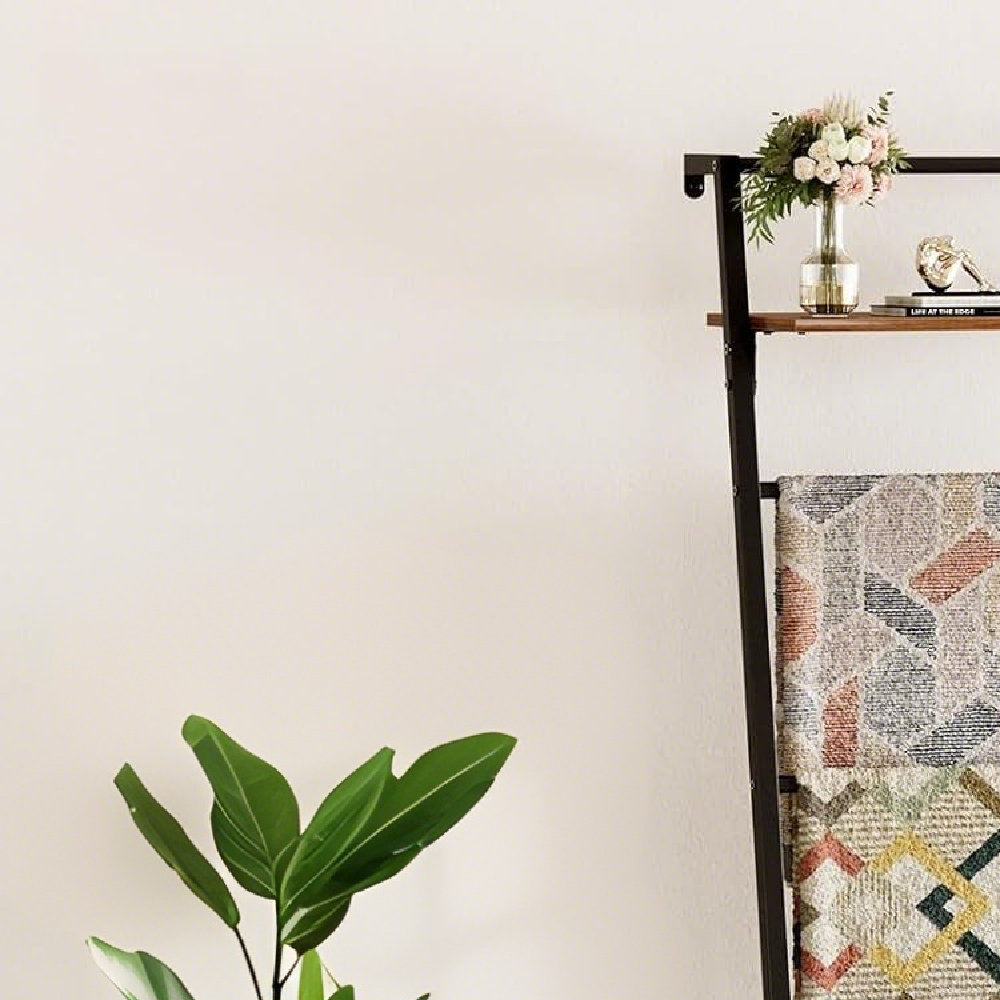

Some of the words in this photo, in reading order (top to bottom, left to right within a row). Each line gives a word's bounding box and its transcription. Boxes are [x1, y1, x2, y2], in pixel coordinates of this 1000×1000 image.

[927, 308, 938, 316] AT
[938, 308, 953, 316] THE
[954, 308, 976, 316] EDGE
